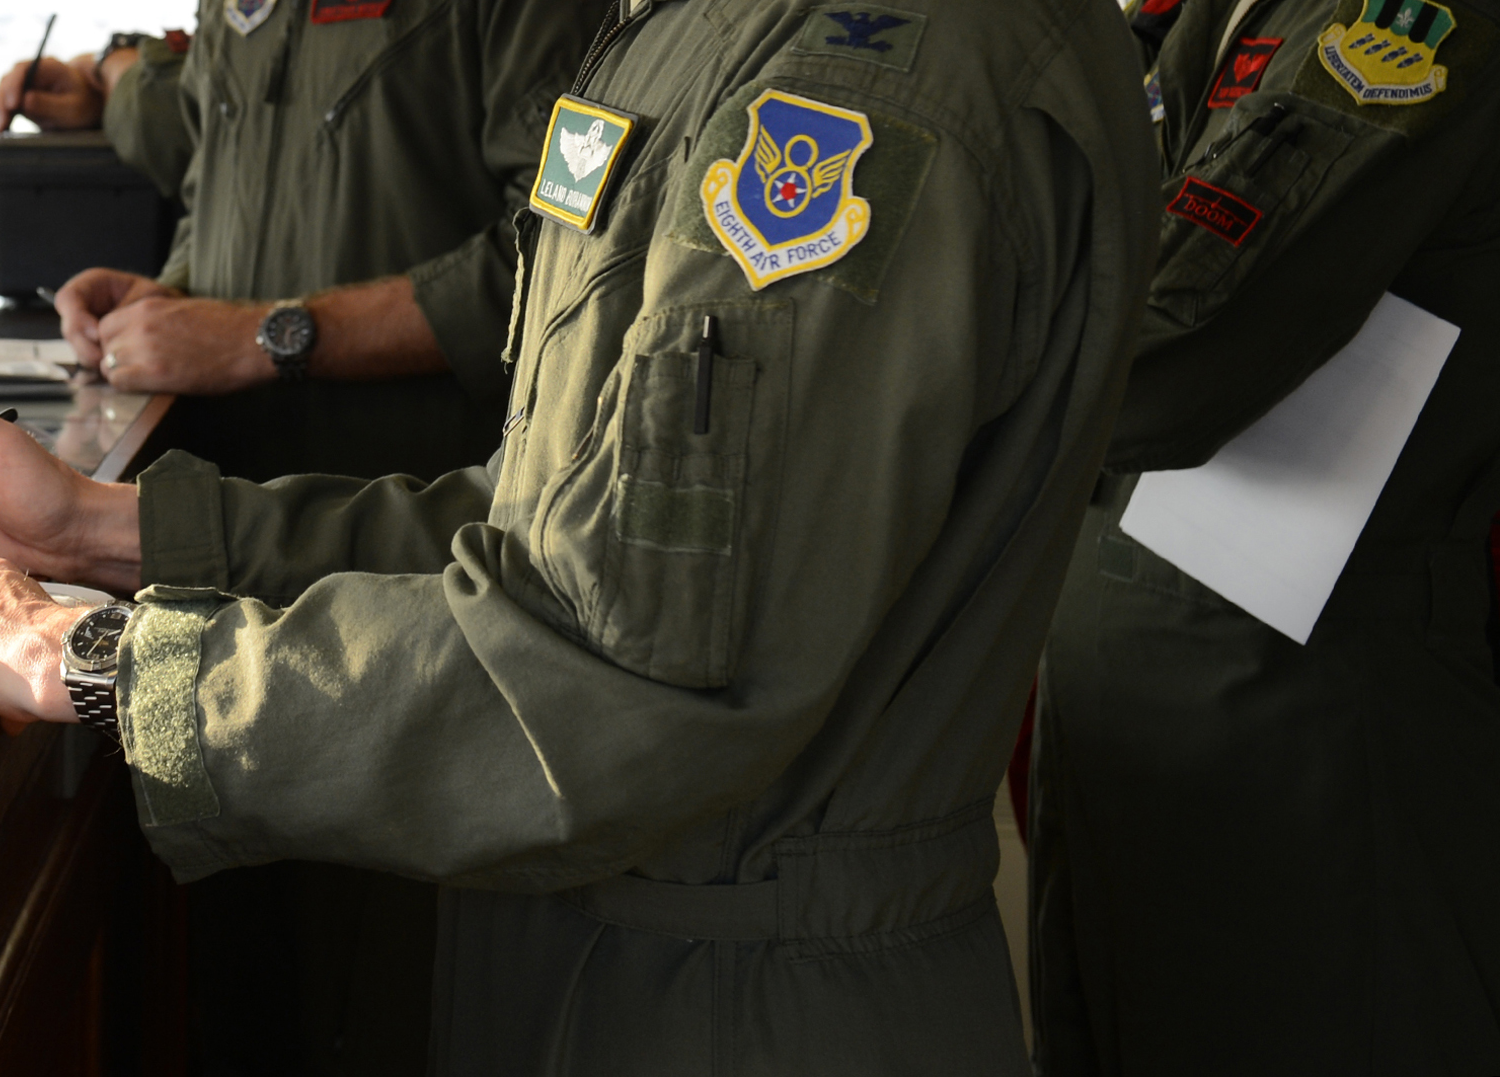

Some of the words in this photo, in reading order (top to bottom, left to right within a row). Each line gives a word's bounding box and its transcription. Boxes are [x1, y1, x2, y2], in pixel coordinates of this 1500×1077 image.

[1324, 45, 1365, 94] LIBERTATEM
[1362, 83, 1433, 99] DEFENDIMUS
[540, 178, 567, 203] LELAND
[714, 200, 757, 253] EIGHTH
[749, 250, 781, 271] AIR
[786, 230, 841, 264] FORCE
[1183, 198, 1234, 231] DOOM
